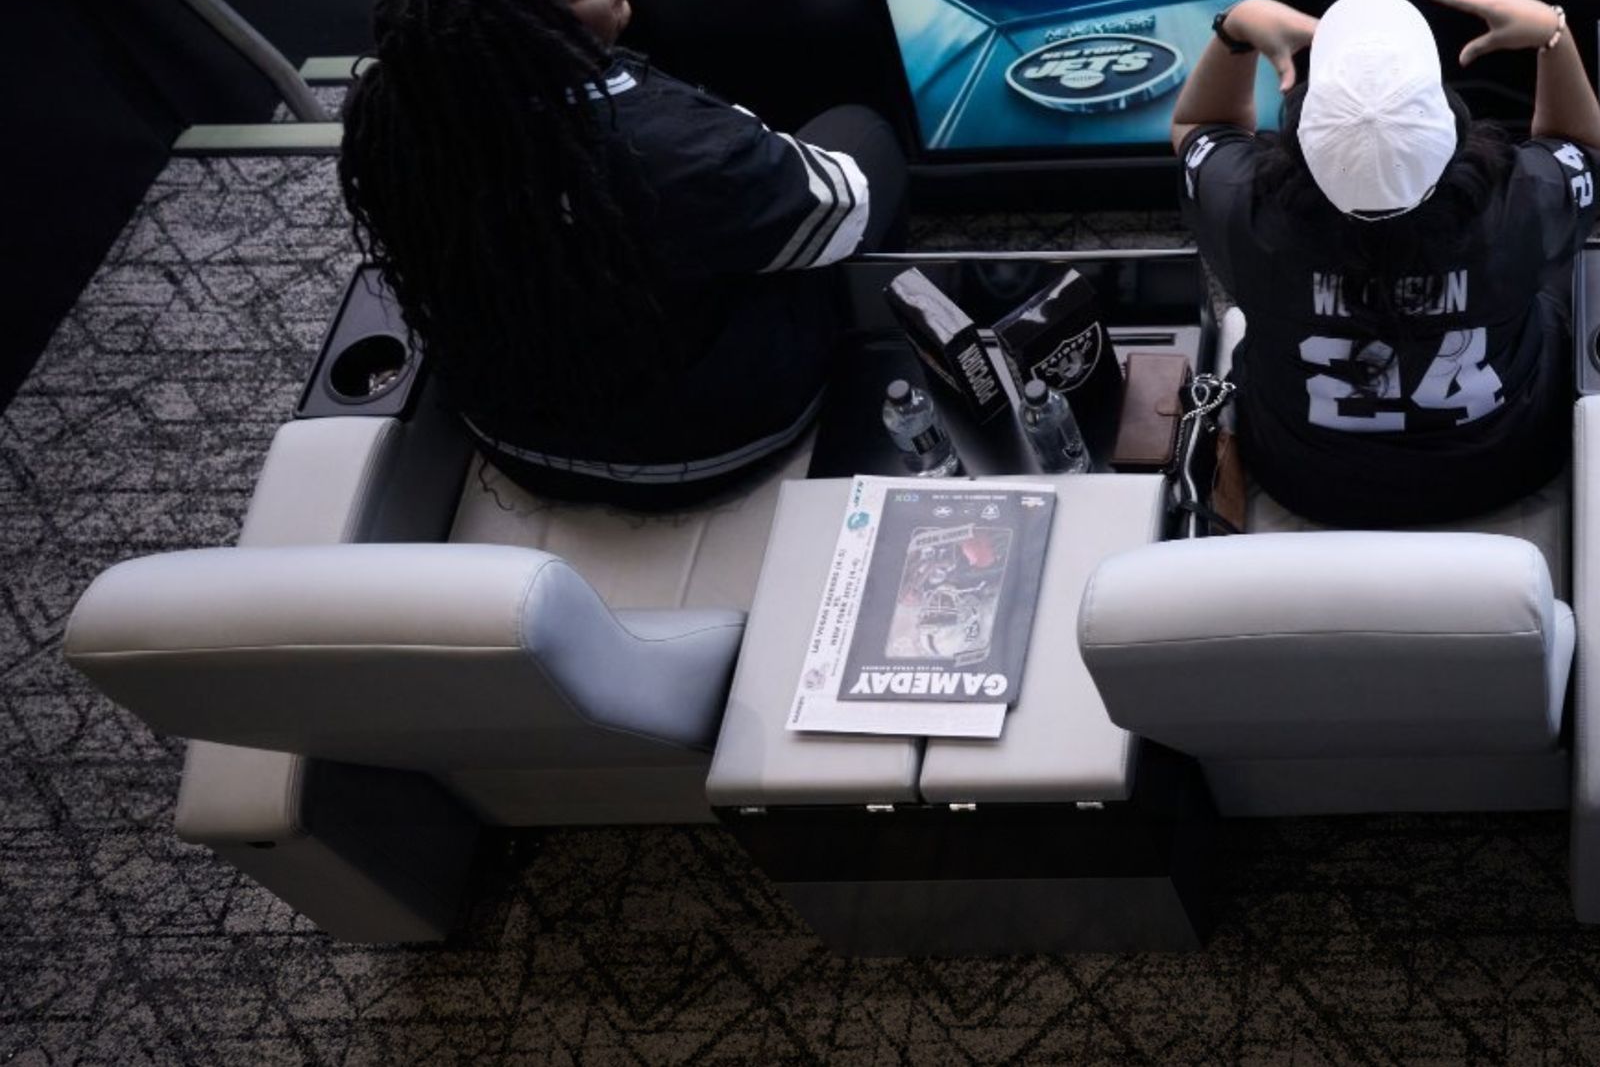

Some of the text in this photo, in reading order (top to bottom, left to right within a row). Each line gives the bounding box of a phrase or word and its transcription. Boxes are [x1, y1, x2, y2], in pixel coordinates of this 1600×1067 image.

[1024, 51, 1153, 79] JETS
[957, 342, 999, 405] POPCORN
[1300, 326, 1505, 433] 24
[849, 672, 1009, 697] GAMEDAY
